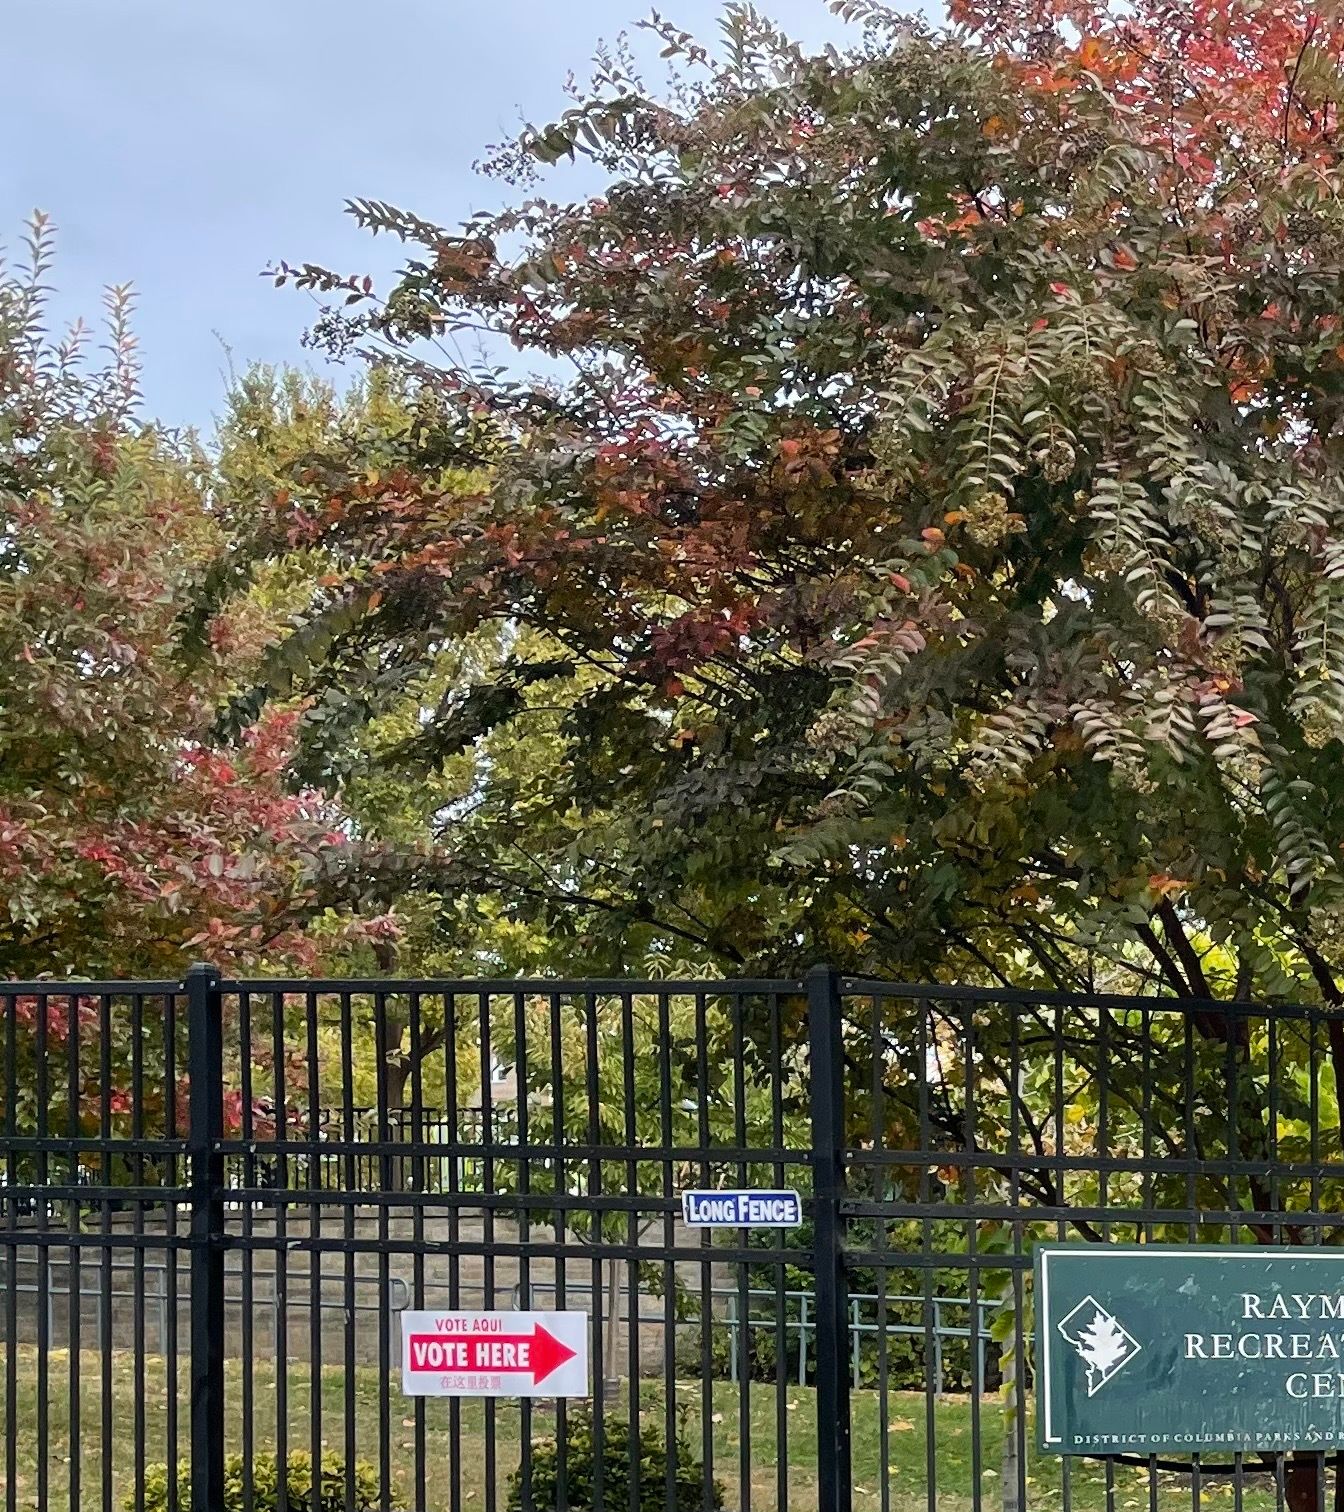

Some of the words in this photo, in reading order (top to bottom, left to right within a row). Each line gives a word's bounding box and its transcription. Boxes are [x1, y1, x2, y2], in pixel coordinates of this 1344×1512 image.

[435, 1319, 467, 1332] VOTE
[473, 1319, 502, 1332] AQUI
[413, 1342, 467, 1367] VOTE
[476, 1343, 529, 1367] HERE
[1075, 1435, 1146, 1444] DISTRICT
[1151, 1435, 1170, 1443] OF
[1174, 1433, 1251, 1443] COLUMBIA
[1256, 1432, 1300, 1441] PARKS
[1304, 1432, 1334, 1441] AND
